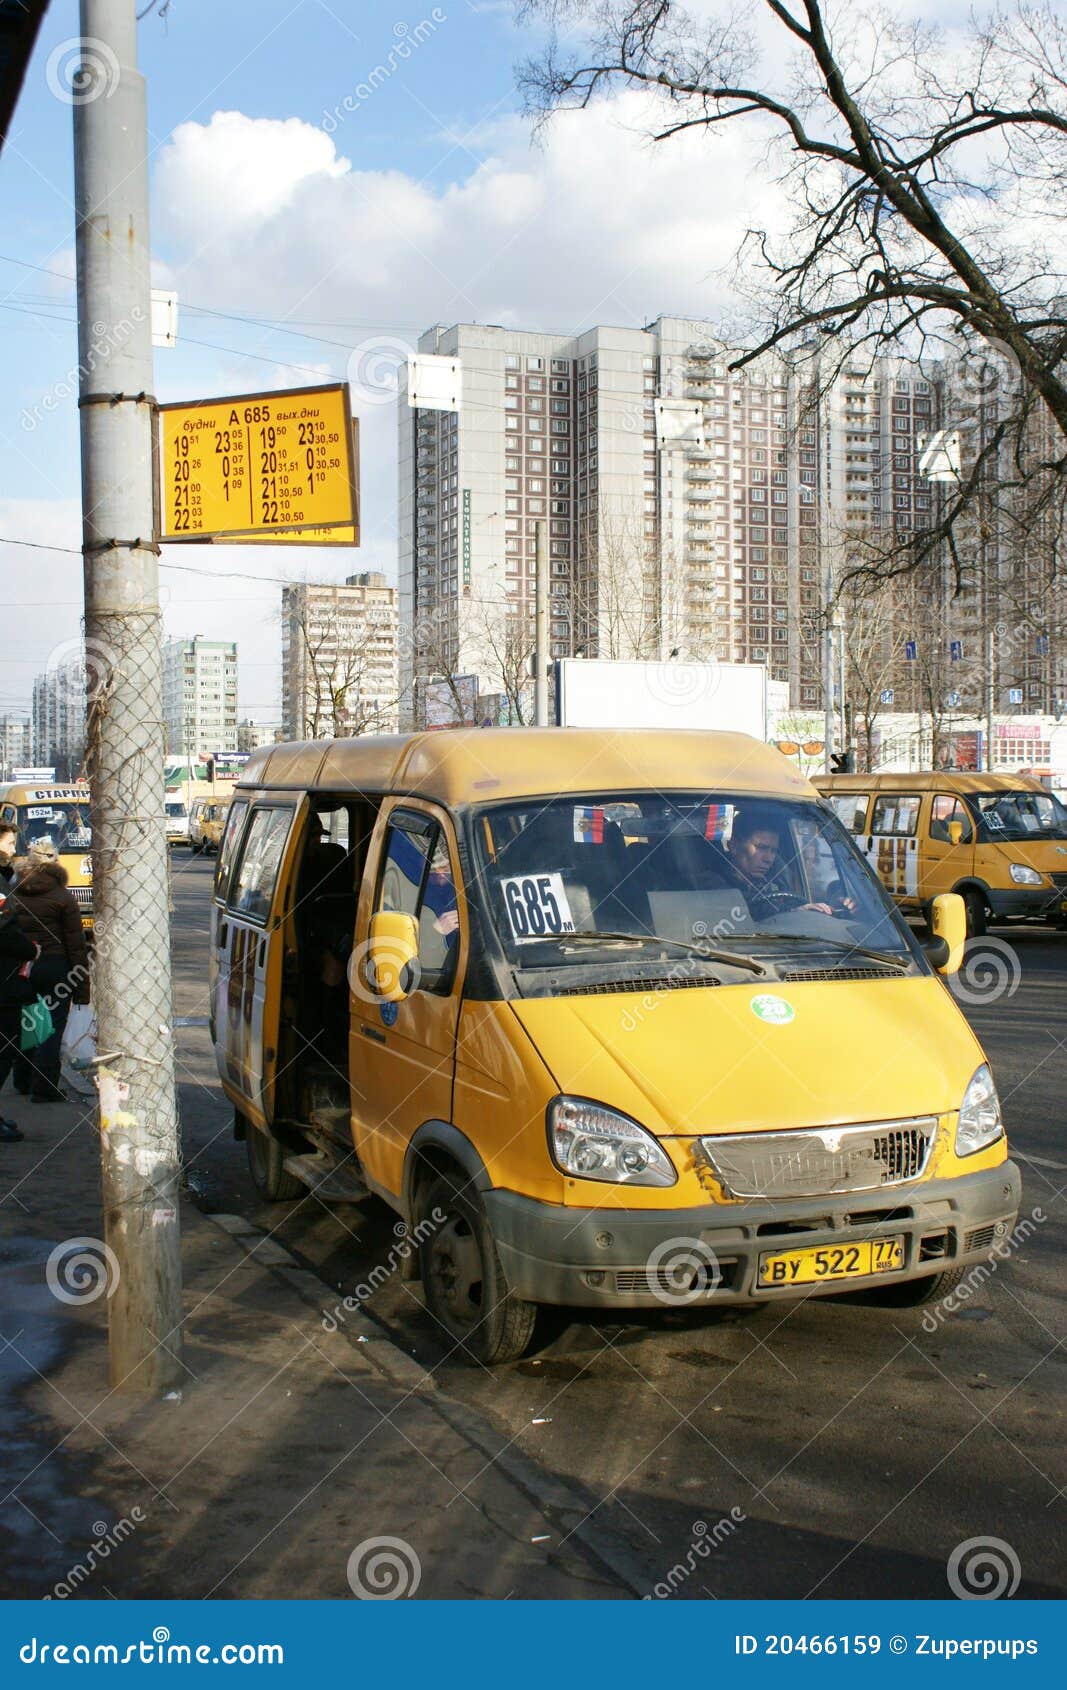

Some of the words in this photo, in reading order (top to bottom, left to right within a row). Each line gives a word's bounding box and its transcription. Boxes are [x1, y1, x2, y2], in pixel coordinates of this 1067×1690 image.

[183, 419, 217, 432] будни
[244, 405, 270, 424] 685
[277, 408, 320, 421] вых.дни
[215, 431, 231, 453] 23
[232, 429, 243, 438] 05
[260, 427, 276, 449] 19
[276, 426, 287, 435] 50
[298, 422, 315, 446] 23
[315, 422, 325, 431] 10
[315, 433, 339, 444] 30,50
[174, 435, 189, 457] 19
[189, 436, 199, 444] 51
[232, 442, 243, 451] 36
[222, 456, 230, 478] 0
[232, 455, 243, 464] 07
[261, 451, 277, 474] 20
[278, 449, 287, 458] 10
[278, 462, 299, 473] 31,51
[306, 448, 315, 470] 0
[316, 447, 326, 456] 10
[316, 458, 340, 470] 30,50
[174, 460, 190, 482] 20
[192, 460, 202, 469] 26
[233, 467, 244, 476] 38
[174, 484, 189, 507] 21
[191, 483, 201, 492] 00
[224, 480, 229, 502] 1
[232, 479, 242, 488] 09
[261, 476, 276, 499] 21
[279, 475, 288, 484] 10
[279, 487, 303, 498] 30,50
[307, 472, 314, 495] 1
[316, 472, 326, 481] 10
[191, 496, 201, 505] 32
[262, 501, 278, 524] 22
[280, 500, 290, 509] 10
[174, 508, 190, 530] 22
[192, 507, 202, 516] 03
[192, 520, 203, 529] 34
[280, 511, 304, 522] 30,50
[505, 878, 562, 936] 685
[814, 1248, 860, 1276] 522
[875, 1241, 896, 1261] 77
[876, 1261, 893, 1269] RUS
